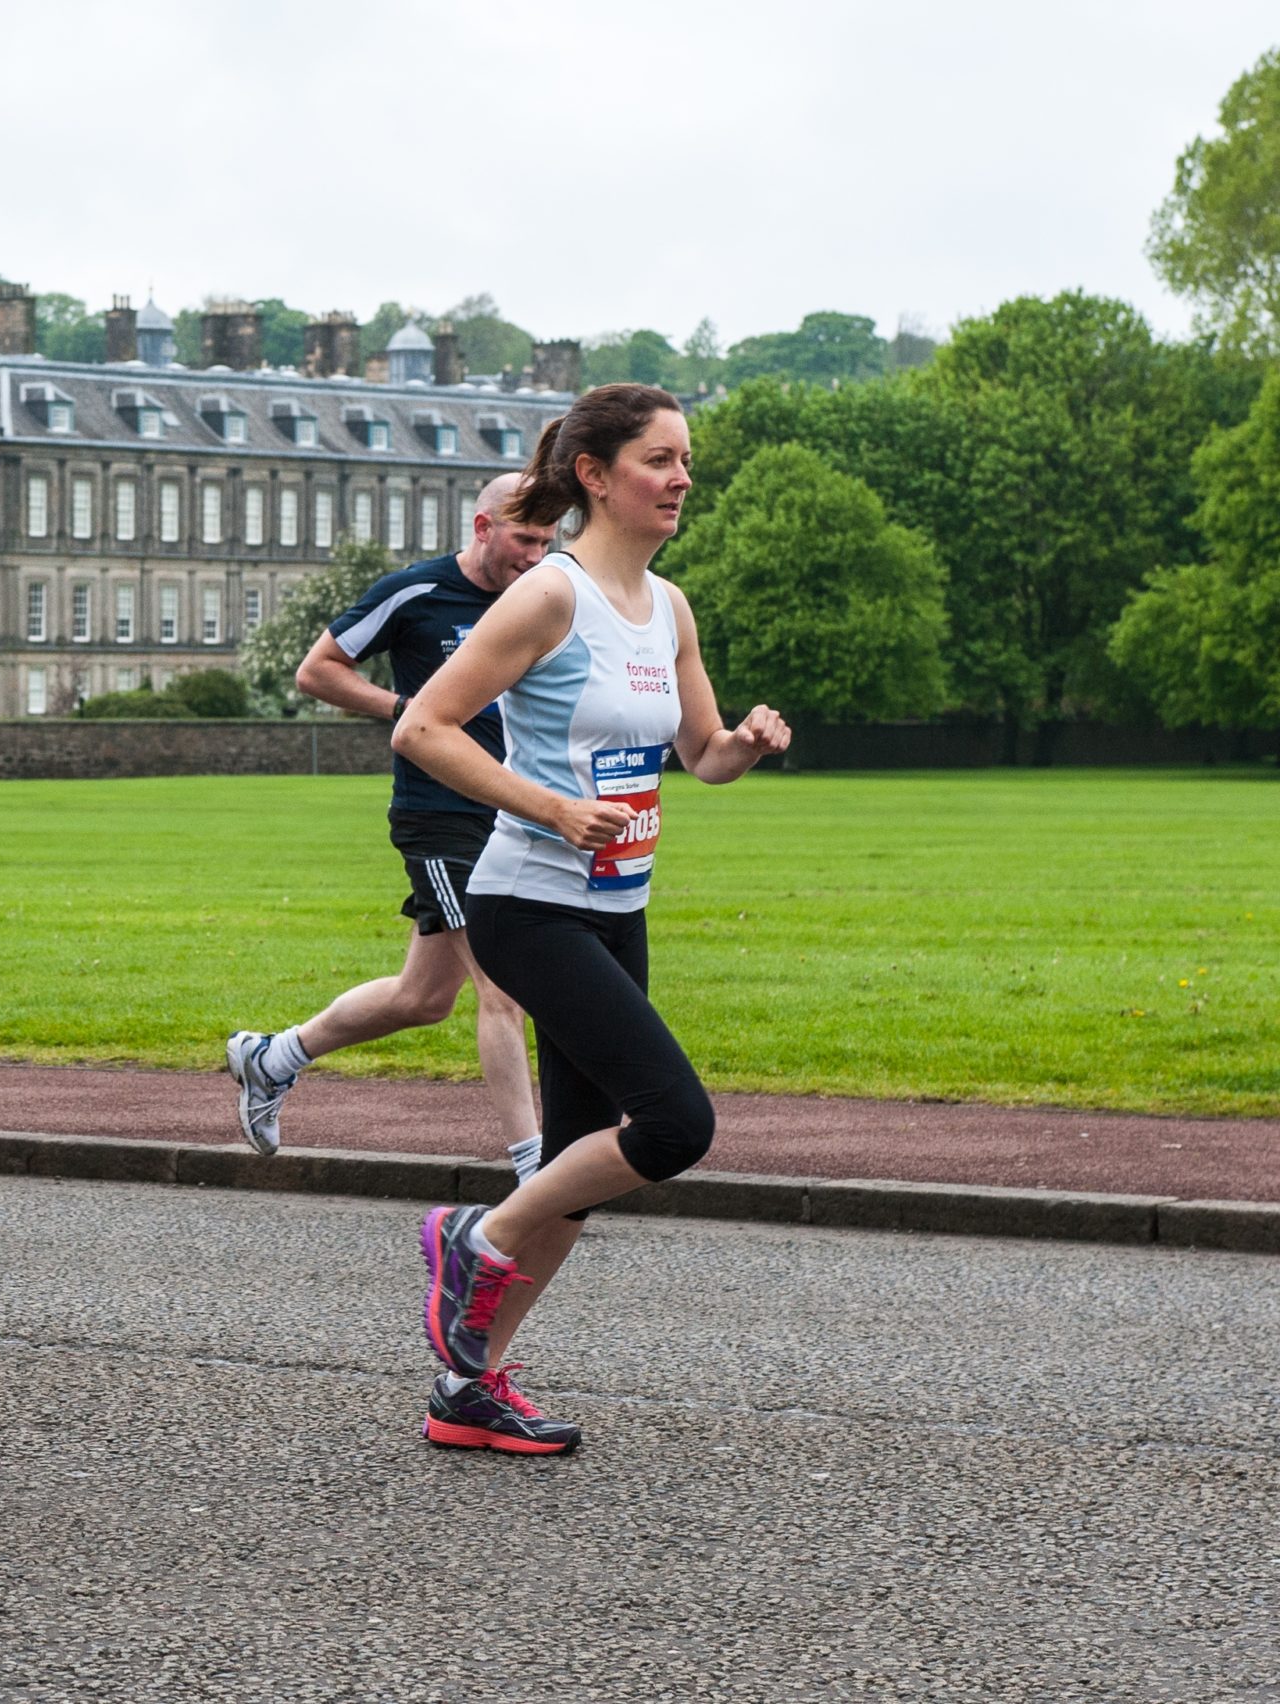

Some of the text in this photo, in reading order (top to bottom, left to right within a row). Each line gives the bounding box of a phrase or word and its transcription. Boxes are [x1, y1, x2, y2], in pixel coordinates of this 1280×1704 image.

[626, 661, 668, 679] forward
[630, 680, 662, 695] space
[626, 752, 646, 767] 10K
